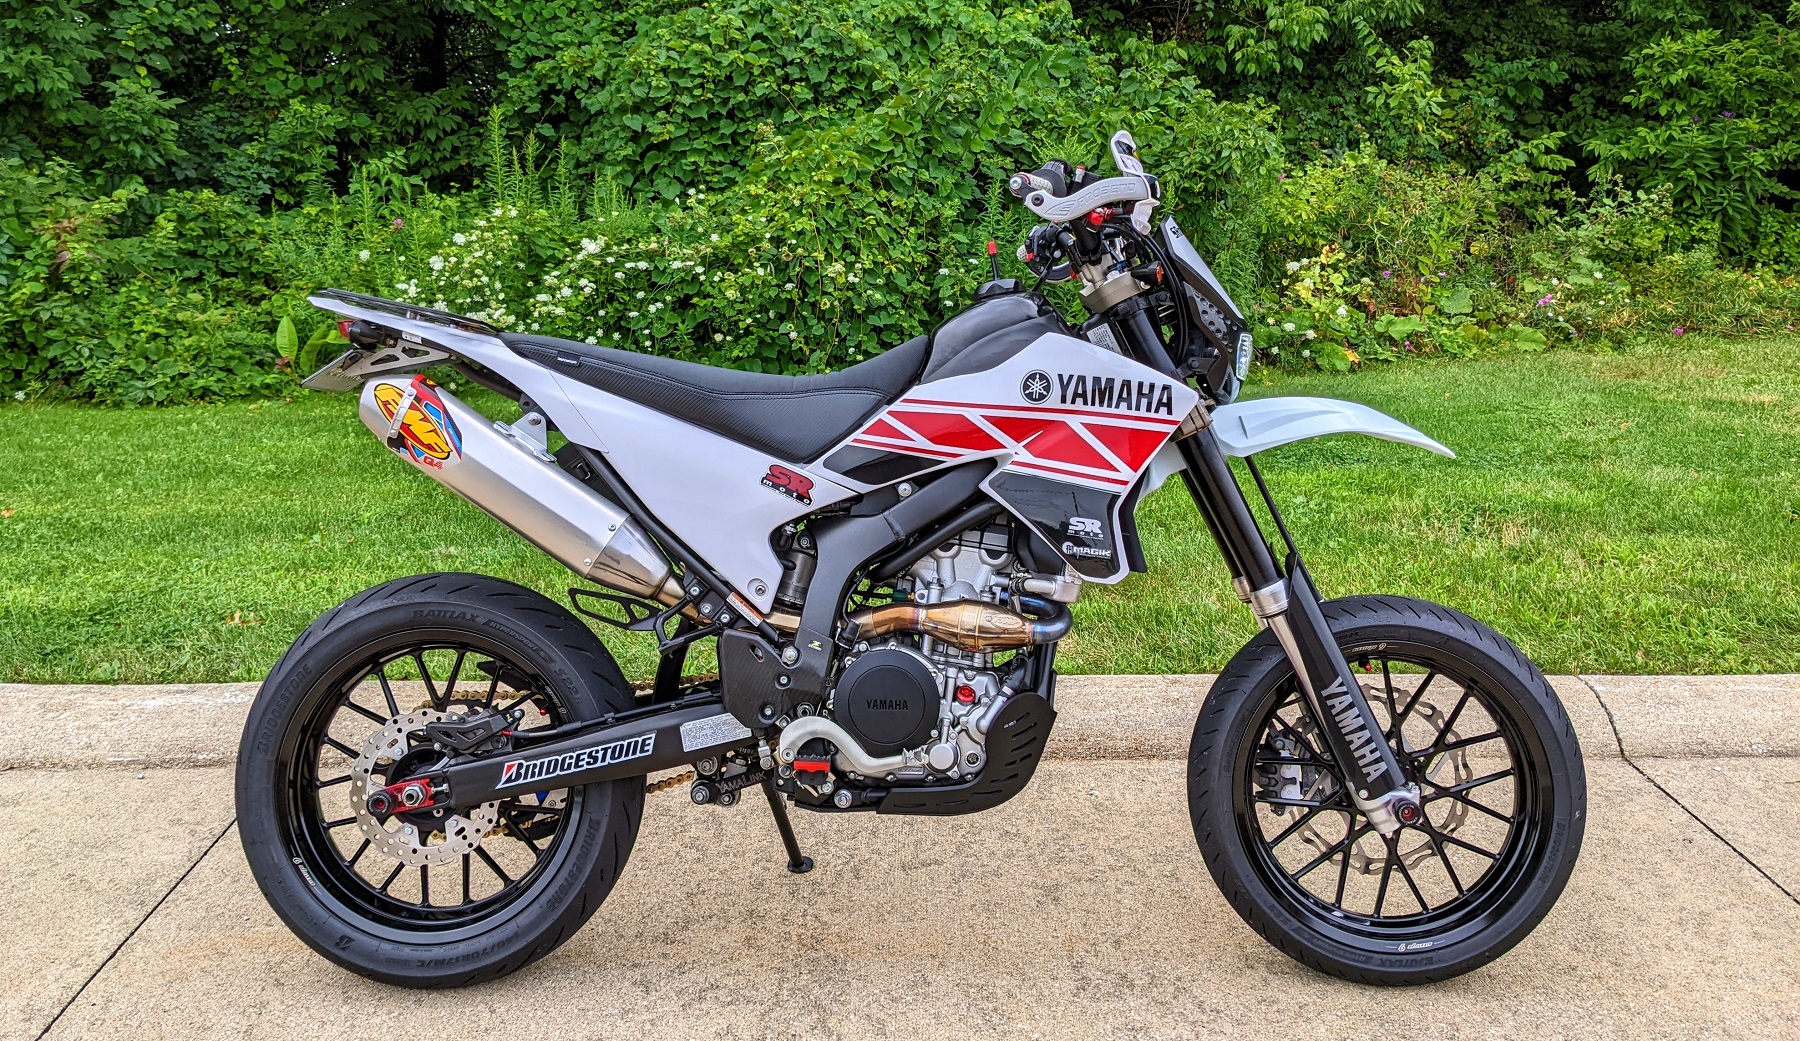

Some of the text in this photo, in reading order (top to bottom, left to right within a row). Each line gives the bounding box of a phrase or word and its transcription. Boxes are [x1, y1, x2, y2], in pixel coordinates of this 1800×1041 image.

[1057, 373, 1173, 415] YAMAHA
[423, 456, 444, 470] Q4
[762, 479, 810, 504] moto
[765, 464, 814, 500] SR
[1067, 529, 1104, 538] moto
[1068, 517, 1102, 533] SR
[257, 662, 312, 752] BRIDGESTONE
[866, 699, 909, 710] YAMAHA
[1321, 676, 1388, 784] YAMAHA
[498, 735, 654, 788] BRIDGESTONE
